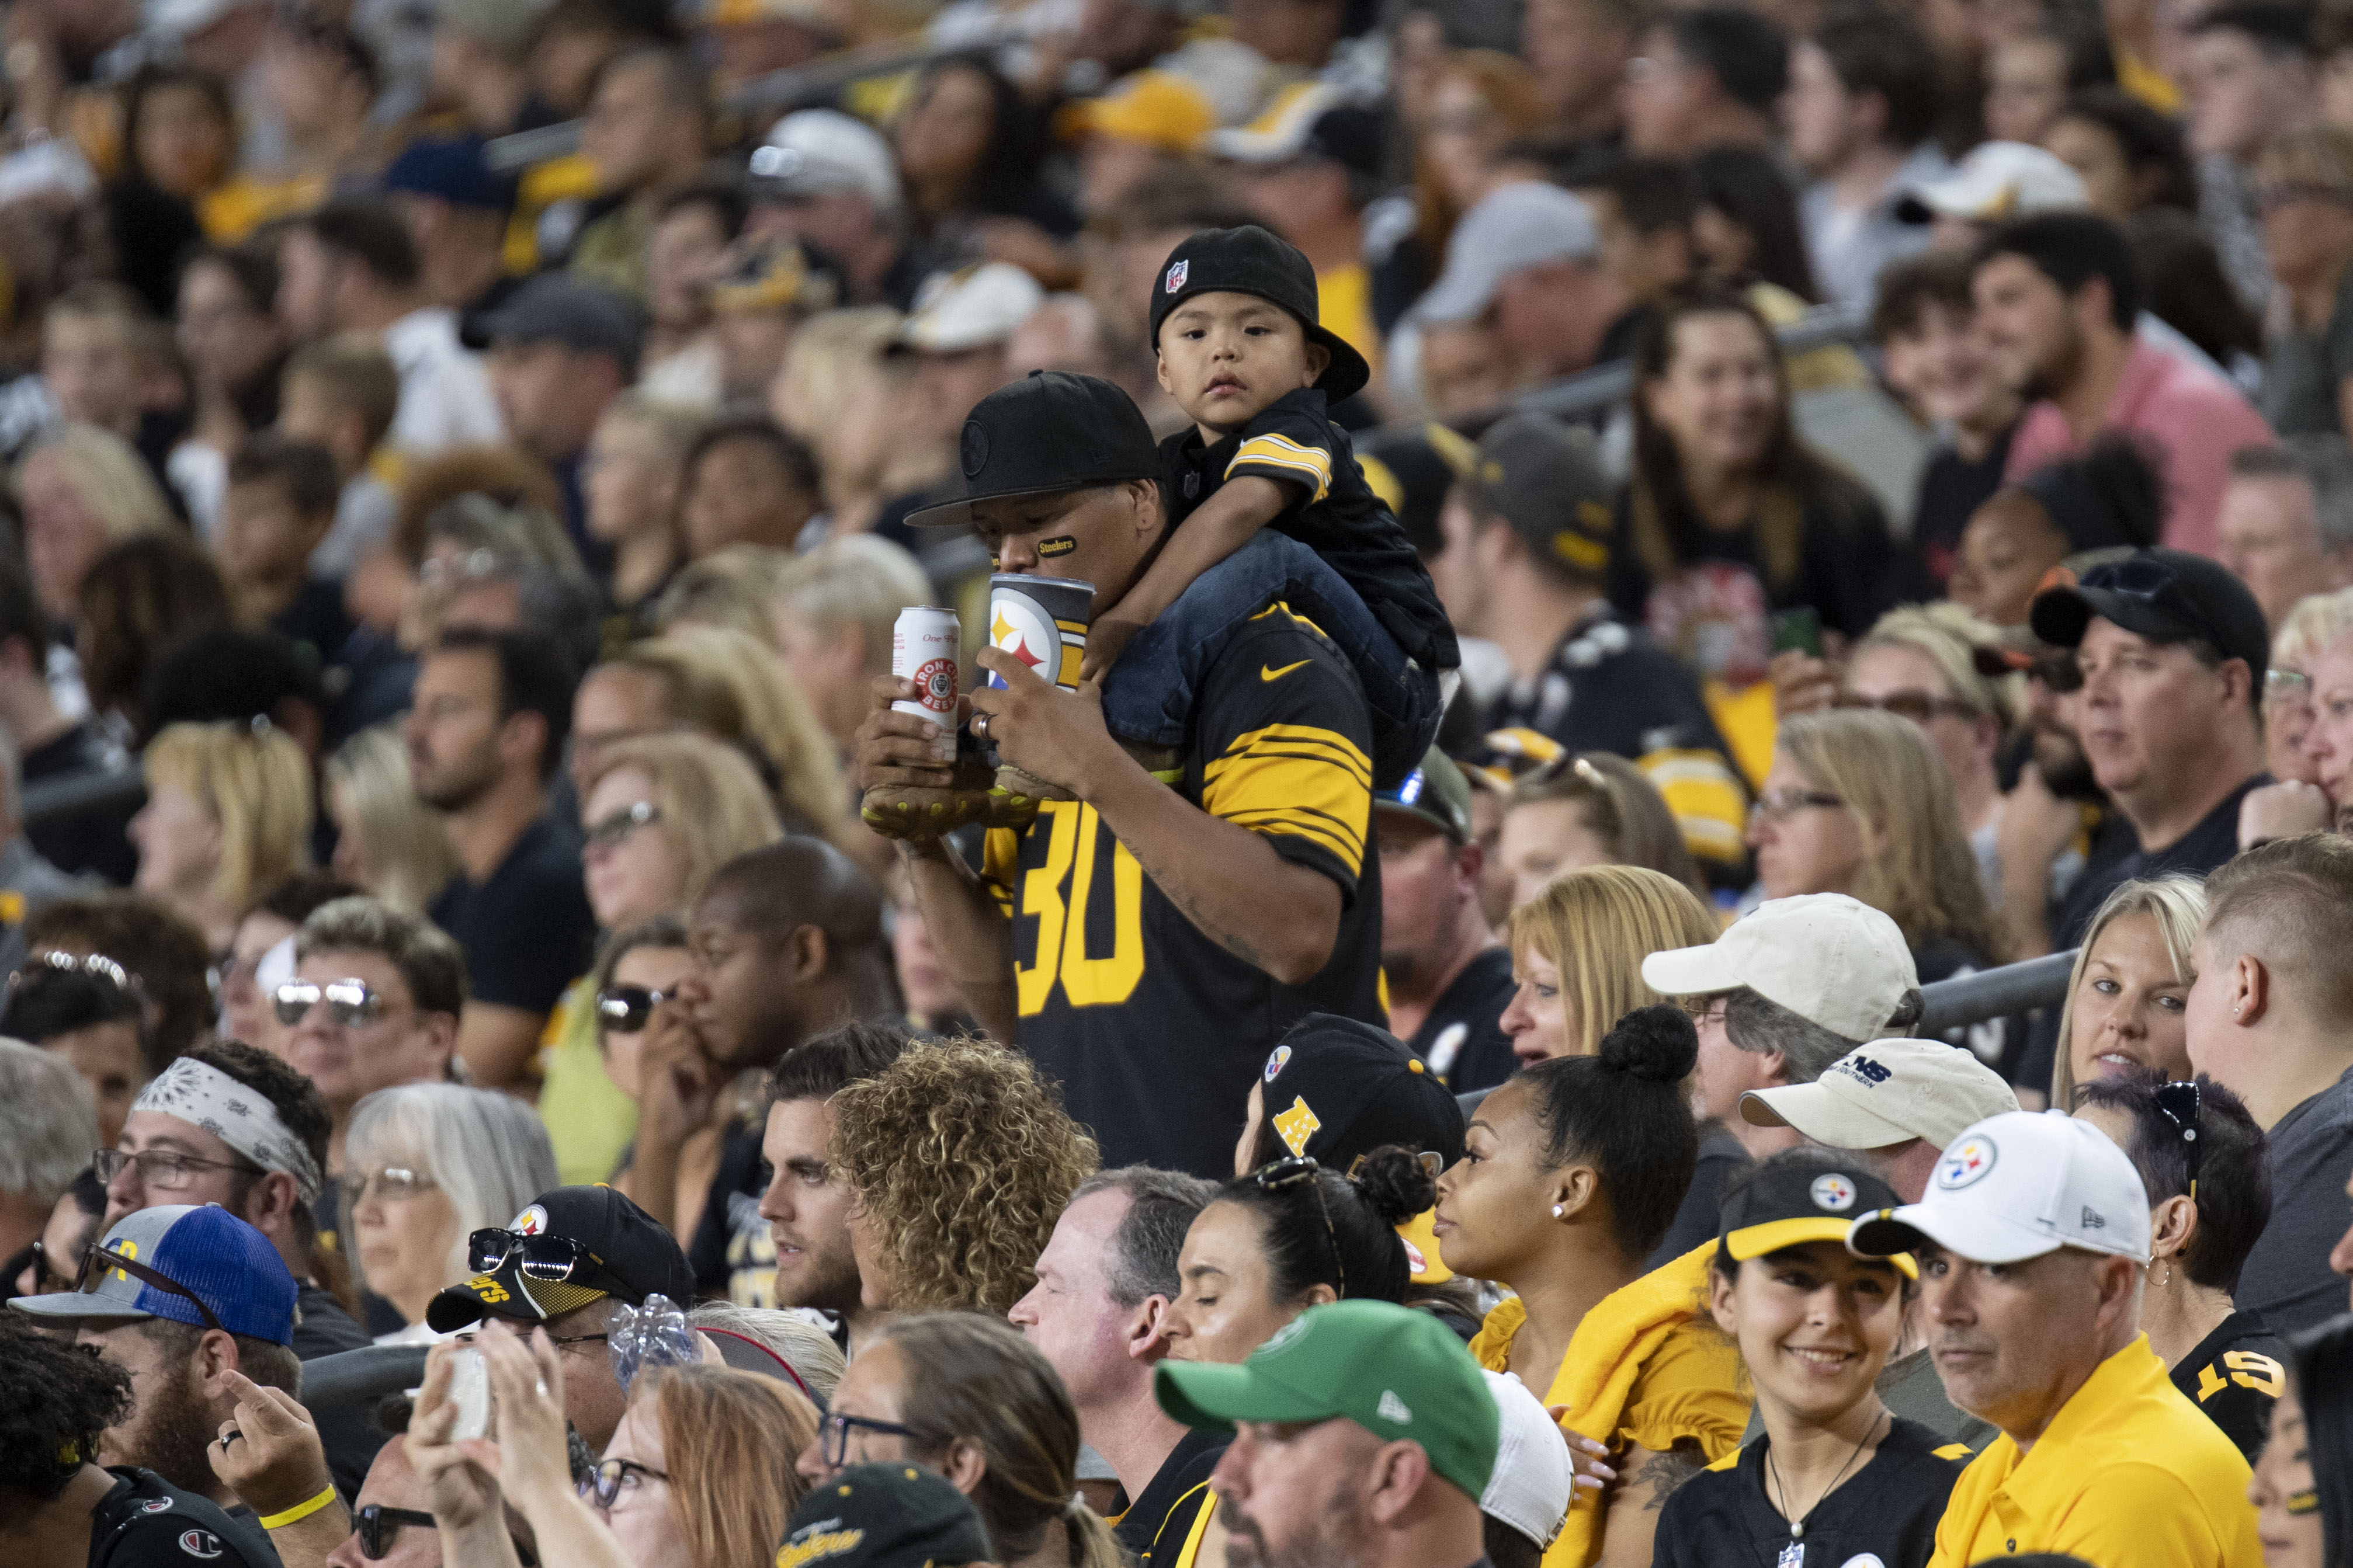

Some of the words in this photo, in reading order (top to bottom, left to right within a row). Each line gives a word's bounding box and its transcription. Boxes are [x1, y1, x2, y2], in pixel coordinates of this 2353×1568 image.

[1039, 540, 1073, 554] Steelers
[916, 660, 944, 685] IRON
[922, 695, 955, 709] BEER
[1014, 800, 1146, 1017] 30
[2196, 1350, 2286, 1403] 19
